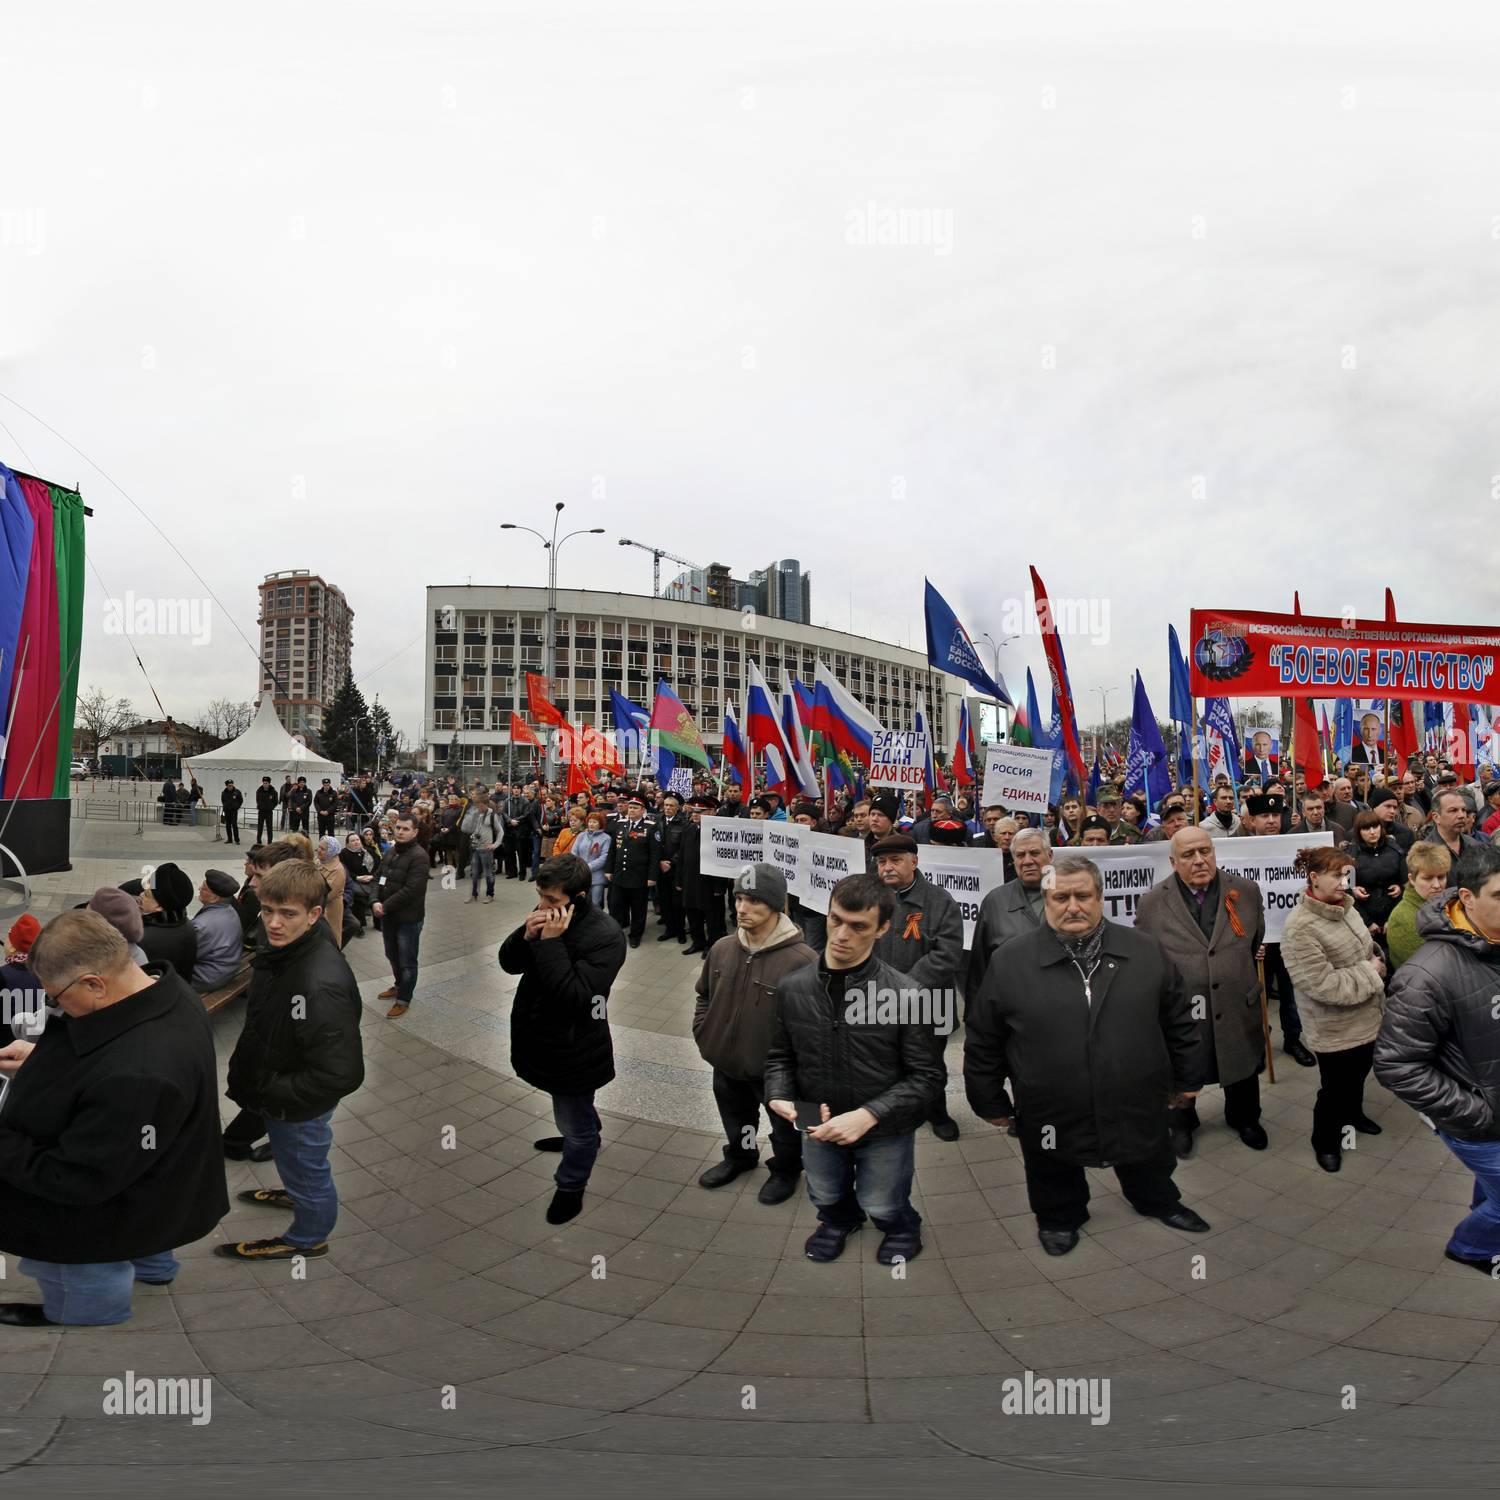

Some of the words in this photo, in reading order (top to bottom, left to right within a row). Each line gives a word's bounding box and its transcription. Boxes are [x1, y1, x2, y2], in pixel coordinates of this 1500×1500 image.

[1249, 624, 1326, 638] ВСЕРОССИЙСКАЯ
[1328, 629, 1400, 641] ОБЩЕСТВЕННАЯ
[1401, 632, 1461, 646] ОРГАНИЗАЦИЯ
[873, 731, 926, 749] ЗАКОН
[873, 748, 911, 765] ЕДИН
[870, 765, 897, 782] ДЛЯ
[900, 767, 925, 784] ВСЕХ
[992, 763, 1033, 778] РОССИЯ
[1002, 787, 1046, 803] ЕДИНА!
[712, 828, 734, 843] Россия
[733, 832, 739, 842] и
[740, 830, 764, 846] Украин
[769, 832, 782, 845] Россия
[716, 847, 739, 859] навеки
[740, 849, 764, 862] вместе
[812, 851, 825, 867] Крым
[810, 872, 827, 890] Кубань
